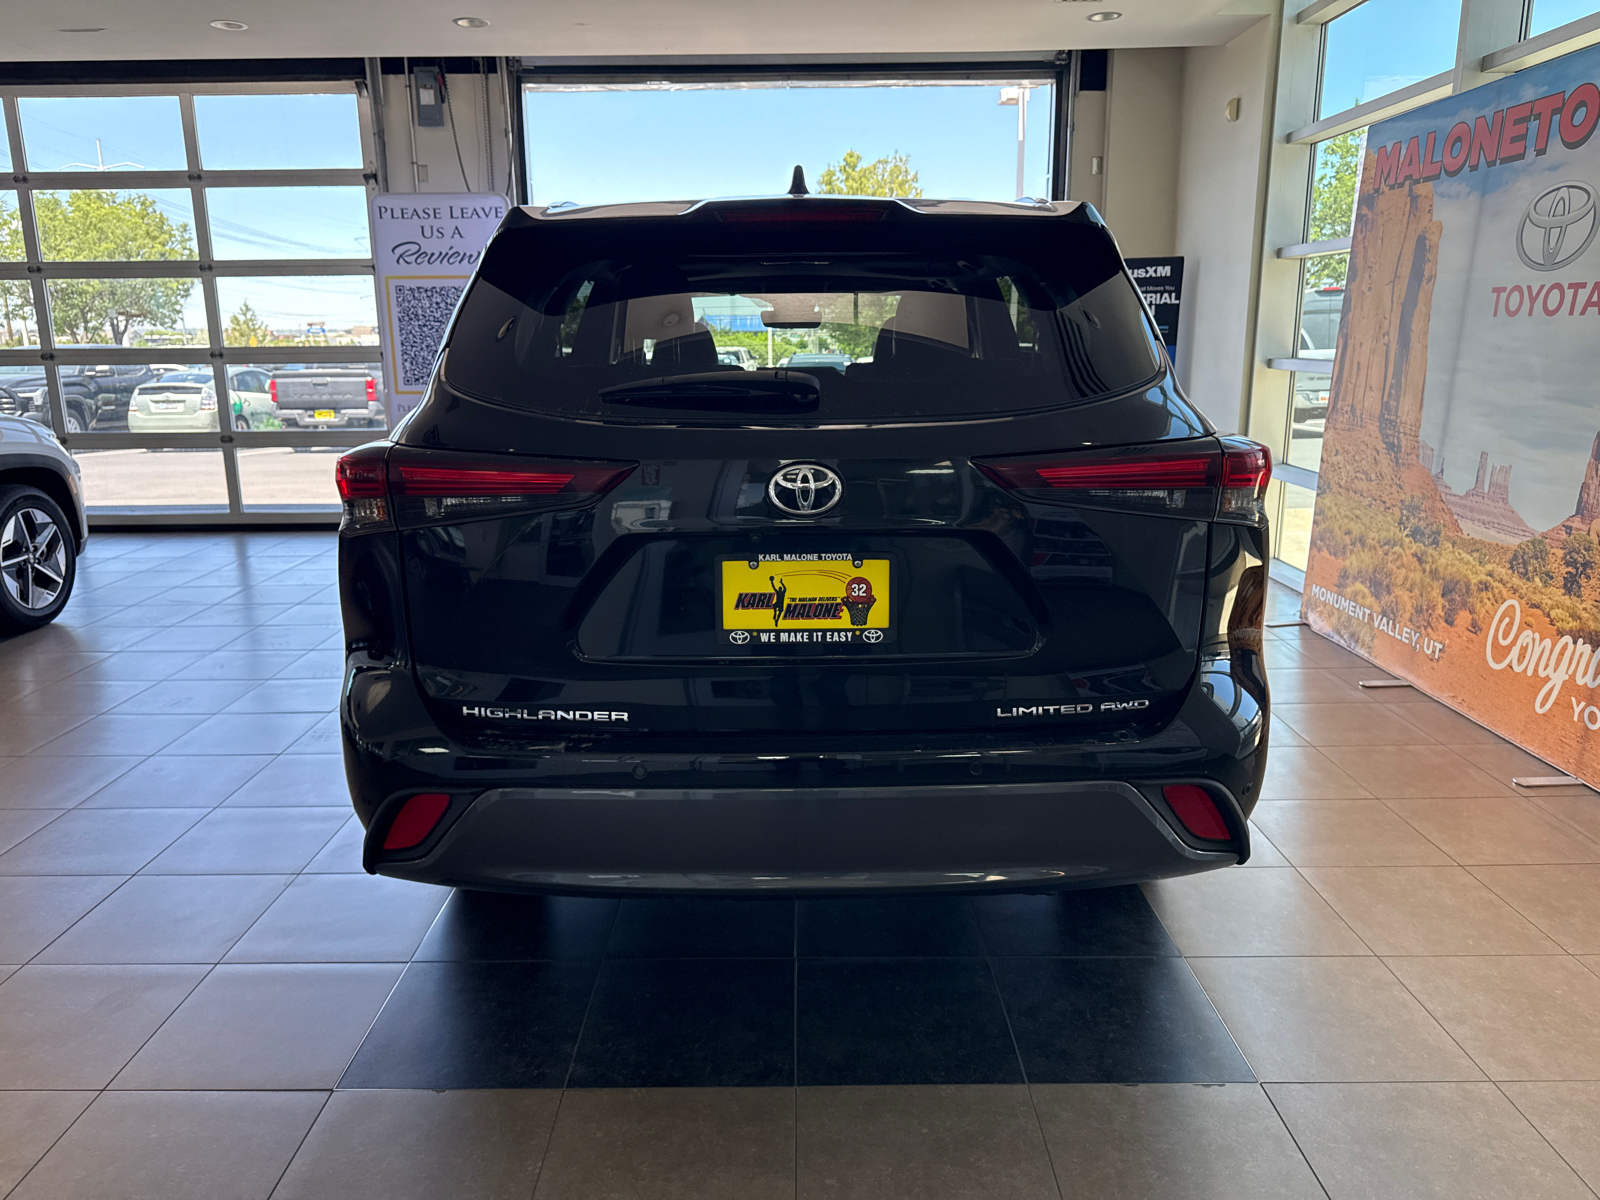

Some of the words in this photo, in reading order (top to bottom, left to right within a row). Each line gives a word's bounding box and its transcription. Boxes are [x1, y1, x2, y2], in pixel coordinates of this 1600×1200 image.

[1373, 82, 1600, 193] MALONETO
[378, 205, 442, 220] PLEASE
[449, 205, 503, 219] LEAVE
[451, 225, 465, 239] A
[391, 241, 482, 265] Review
[1491, 281, 1600, 317] TOYOTA
[758, 553, 782, 562] KARL
[783, 553, 819, 561] MALONE
[820, 553, 853, 561] TOYOTA
[851, 583, 867, 597] 32
[734, 592, 776, 610] KARL
[782, 602, 844, 620] MALONE
[1311, 584, 1371, 623] MONUMENT
[1373, 611, 1420, 652] VALLEY,
[1423, 637, 1443, 659] UT
[760, 632, 776, 643] WE
[780, 632, 809, 642] MAKE
[813, 632, 823, 642] IT
[826, 631, 853, 642] EASY
[462, 706, 629, 722] HIGHLANDER
[996, 703, 1093, 717] LIMITED
[1100, 699, 1149, 712] AWD
[1571, 696, 1600, 730] YO
